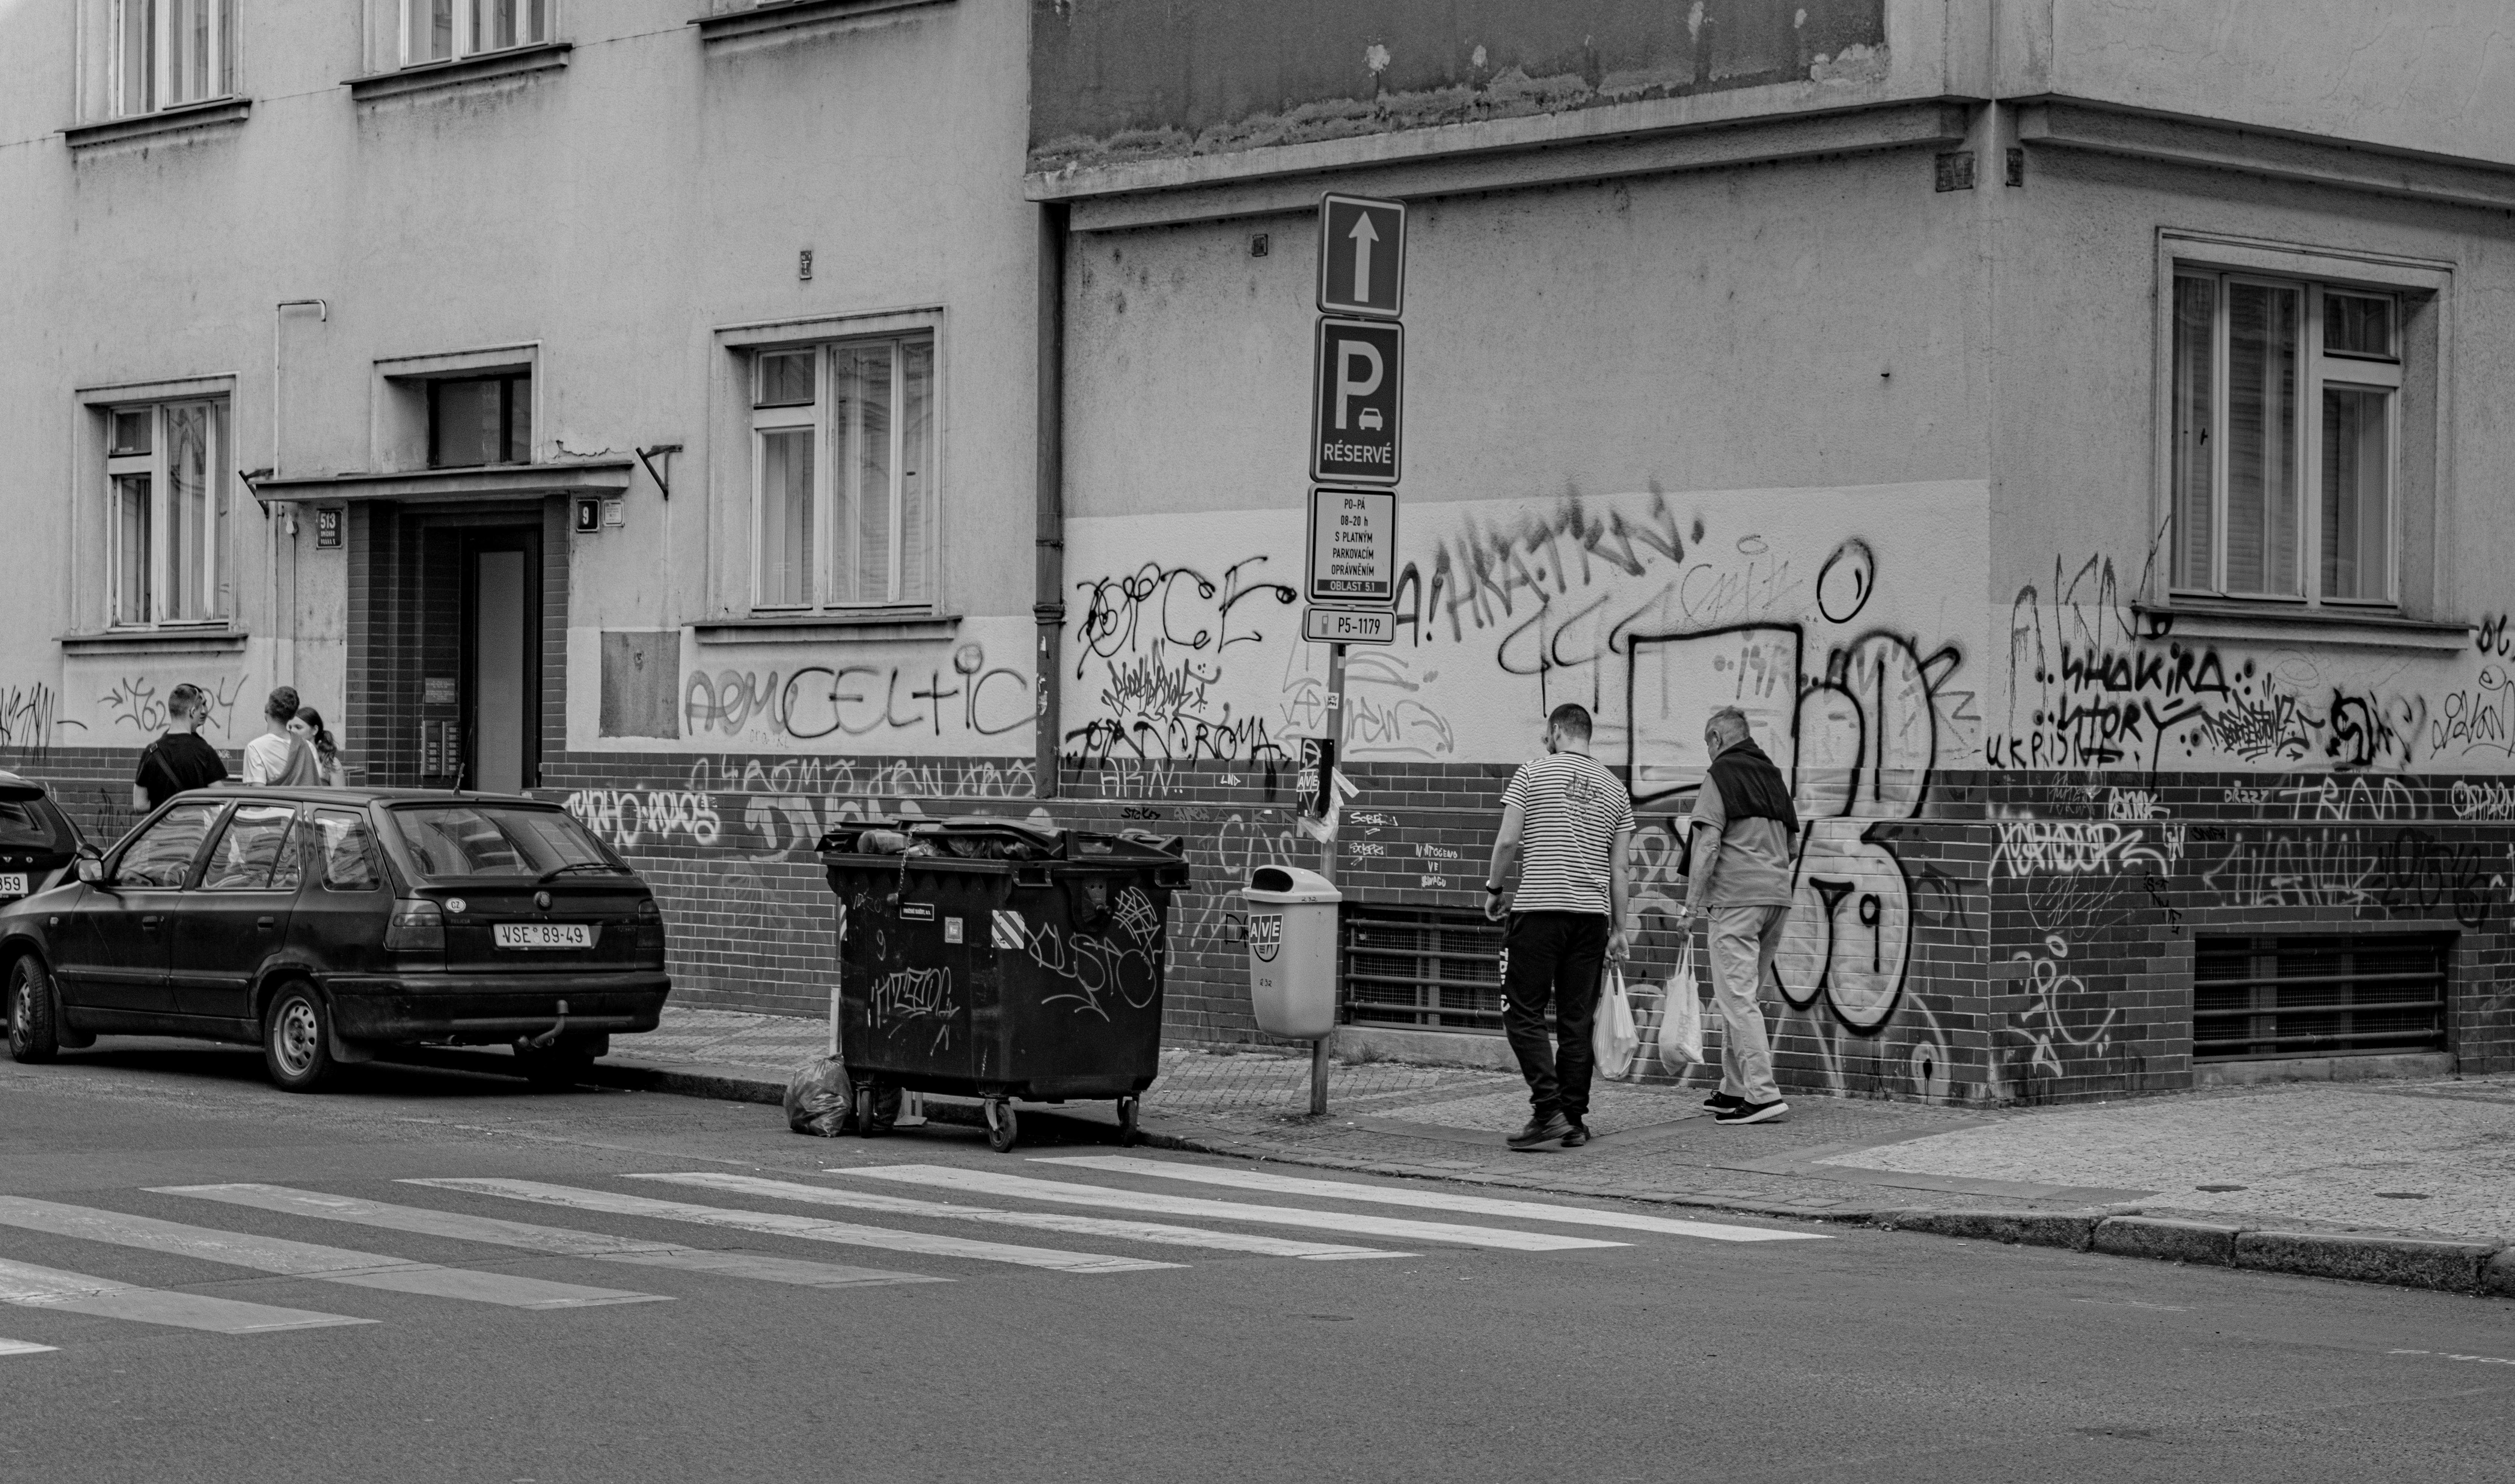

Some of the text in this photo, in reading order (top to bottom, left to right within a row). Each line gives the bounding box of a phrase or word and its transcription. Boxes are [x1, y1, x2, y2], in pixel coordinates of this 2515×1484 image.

[1335, 339, 1384, 430] P
[1324, 440, 1392, 464] RÉSERVÉ
[1344, 497, 1365, 510] PO-PÁ
[321, 513, 336, 529] 513
[583, 507, 589, 525] 9
[1340, 515, 1368, 527] 08-20 h
[1335, 530, 1373, 543] S PLATNÝM
[1333, 547, 1374, 560] PARKOVACÍM
[1331, 562, 1374, 576] OPRÁVNĚNÍM
[1330, 581, 1374, 592] OBLAST 5.1
[1338, 617, 1380, 635] P5-1179
[1298, 775, 1318, 787] AVE
[1428, 860, 1439, 873] VE
[502, 926, 583, 944] VSE 89-49
[1250, 921, 1280, 937] AVE
